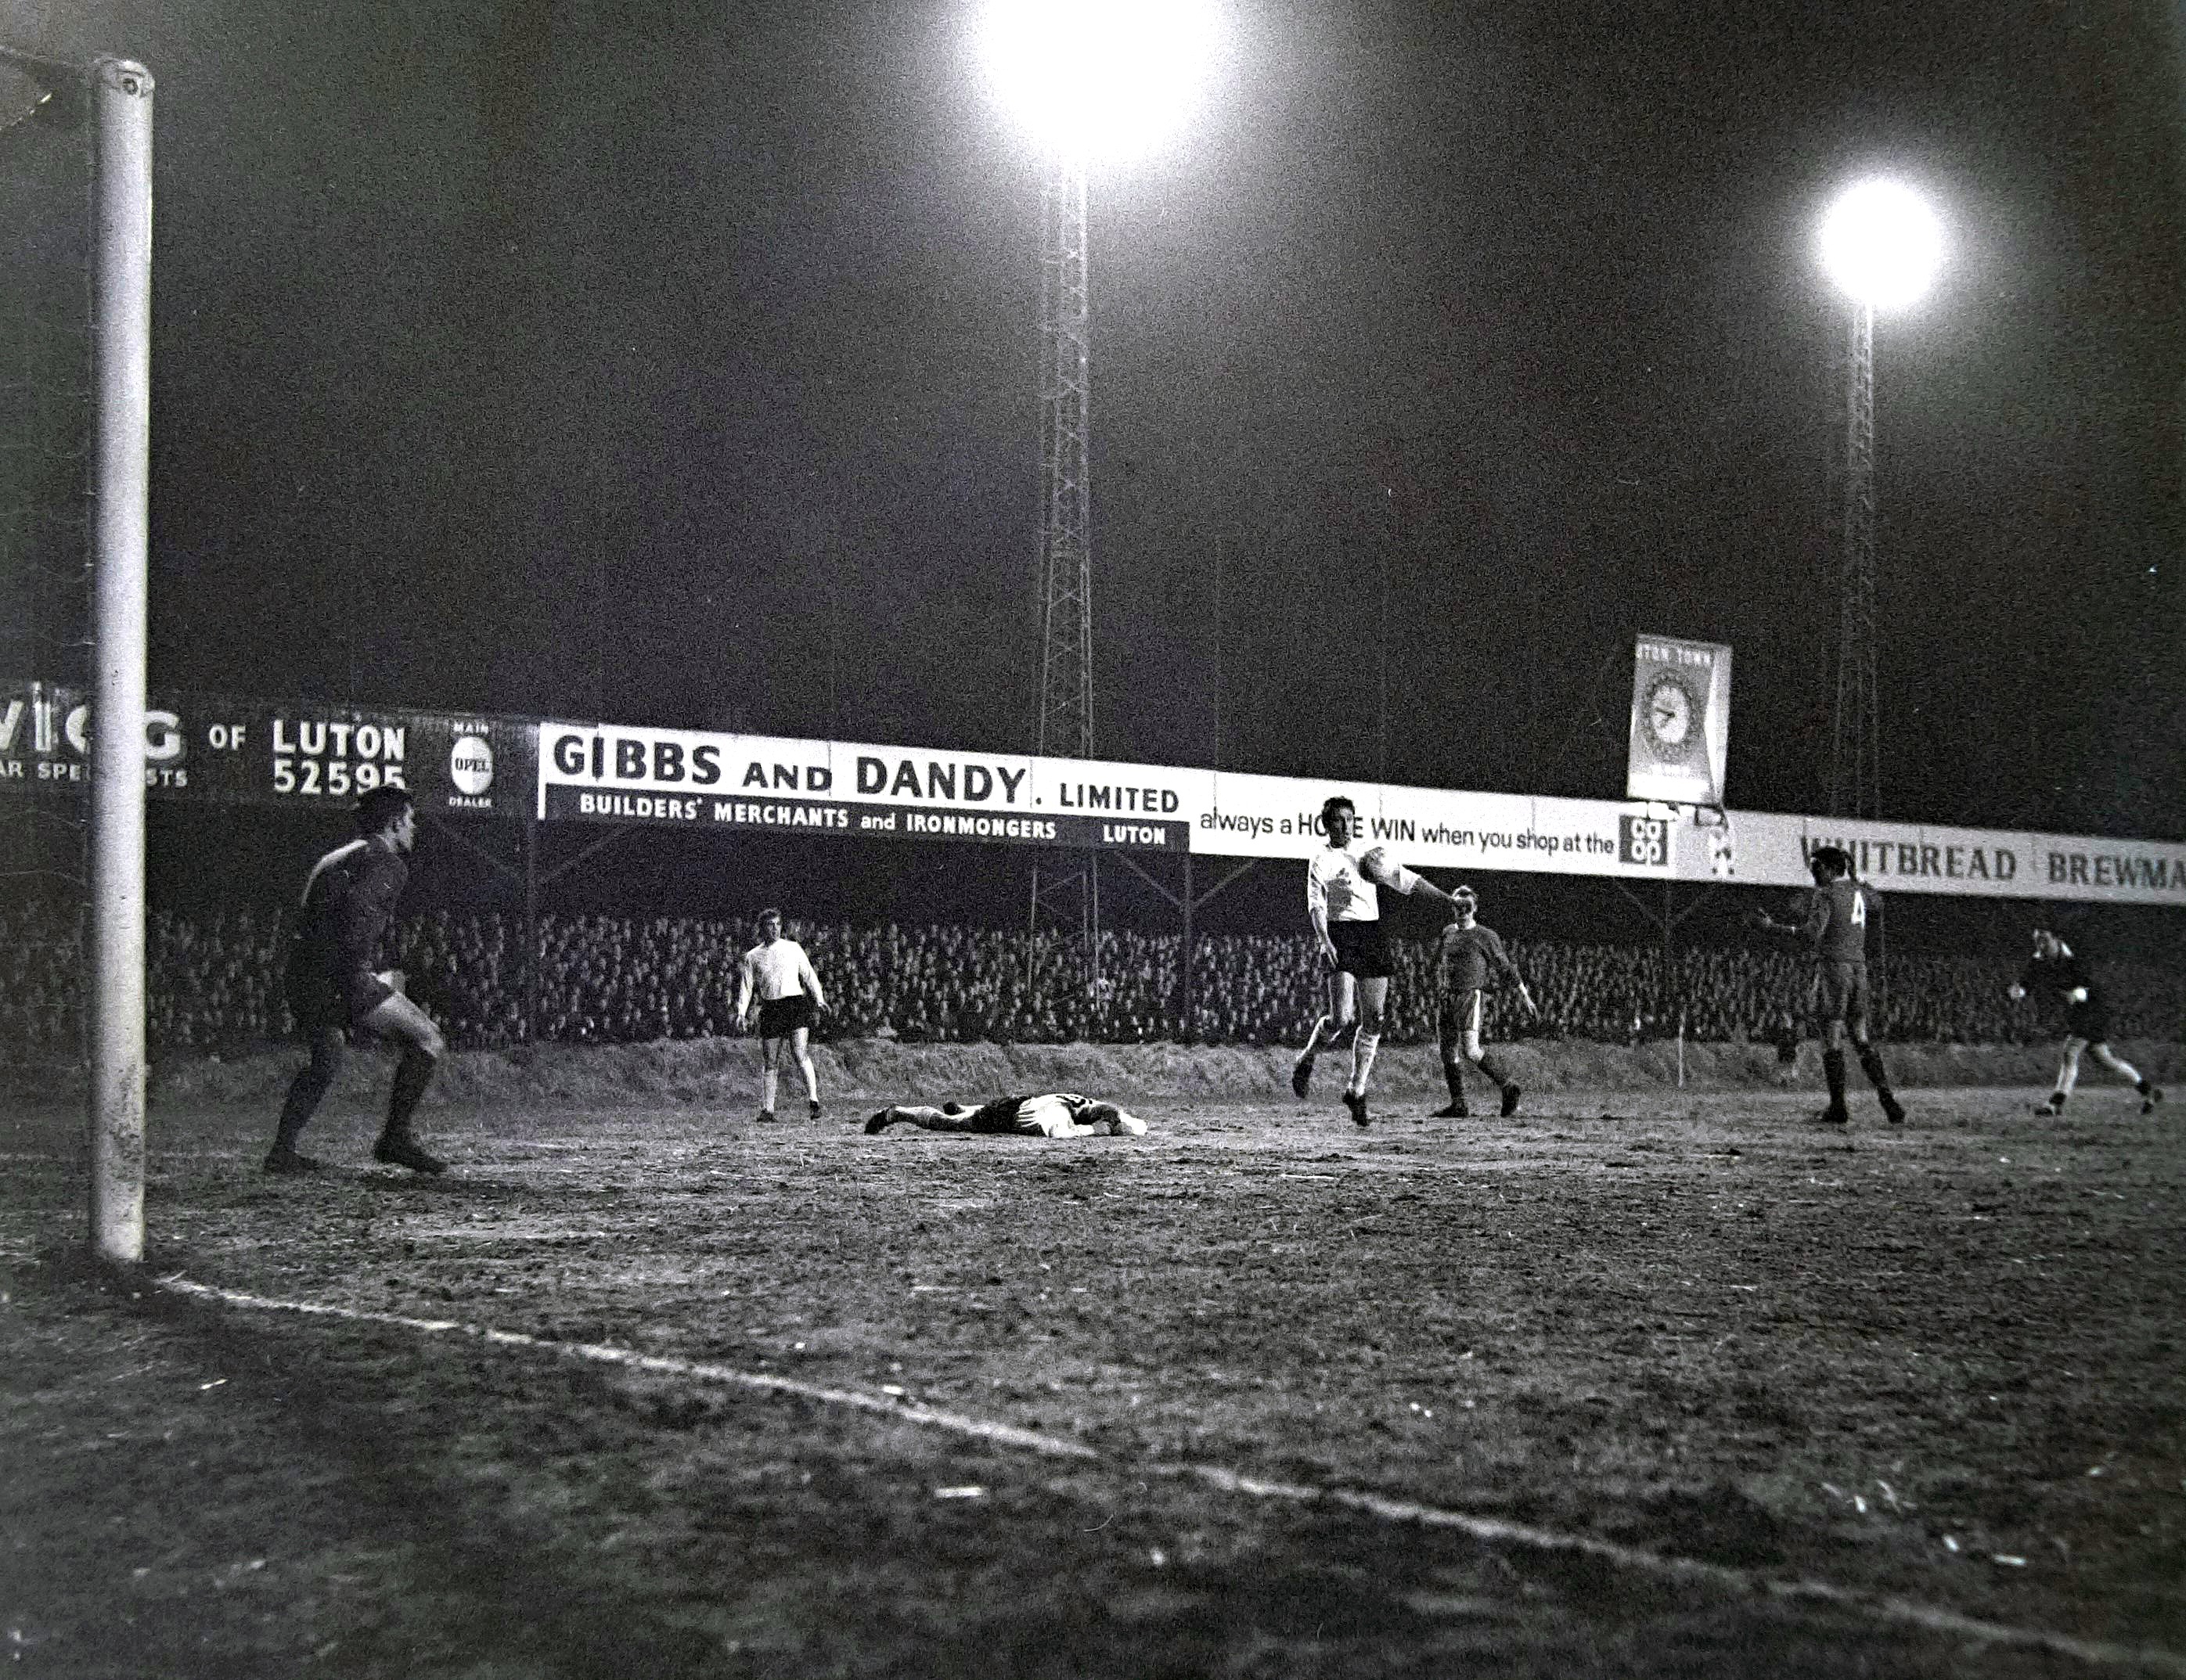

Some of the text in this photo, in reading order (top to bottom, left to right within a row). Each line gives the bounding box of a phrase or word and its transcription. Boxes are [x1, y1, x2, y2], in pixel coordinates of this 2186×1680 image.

[209, 725, 247, 751] OF
[274, 719, 406, 761] LUTON
[38, 763, 188, 787] SPESTS
[274, 758, 406, 795] 52595
[553, 734, 721, 785] GIBBS
[743, 761, 833, 792] AND
[1060, 782, 1180, 813] LIMITED
[715, 800, 848, 828] MERCHANTS
[861, 812, 897, 831] and
[906, 813, 1057, 840] IRONMONGERS
[1103, 823, 1167, 845] LUTON
[1200, 806, 1614, 857] always a HOE WIN when you shop at the
[1851, 890, 1866, 929] 4
